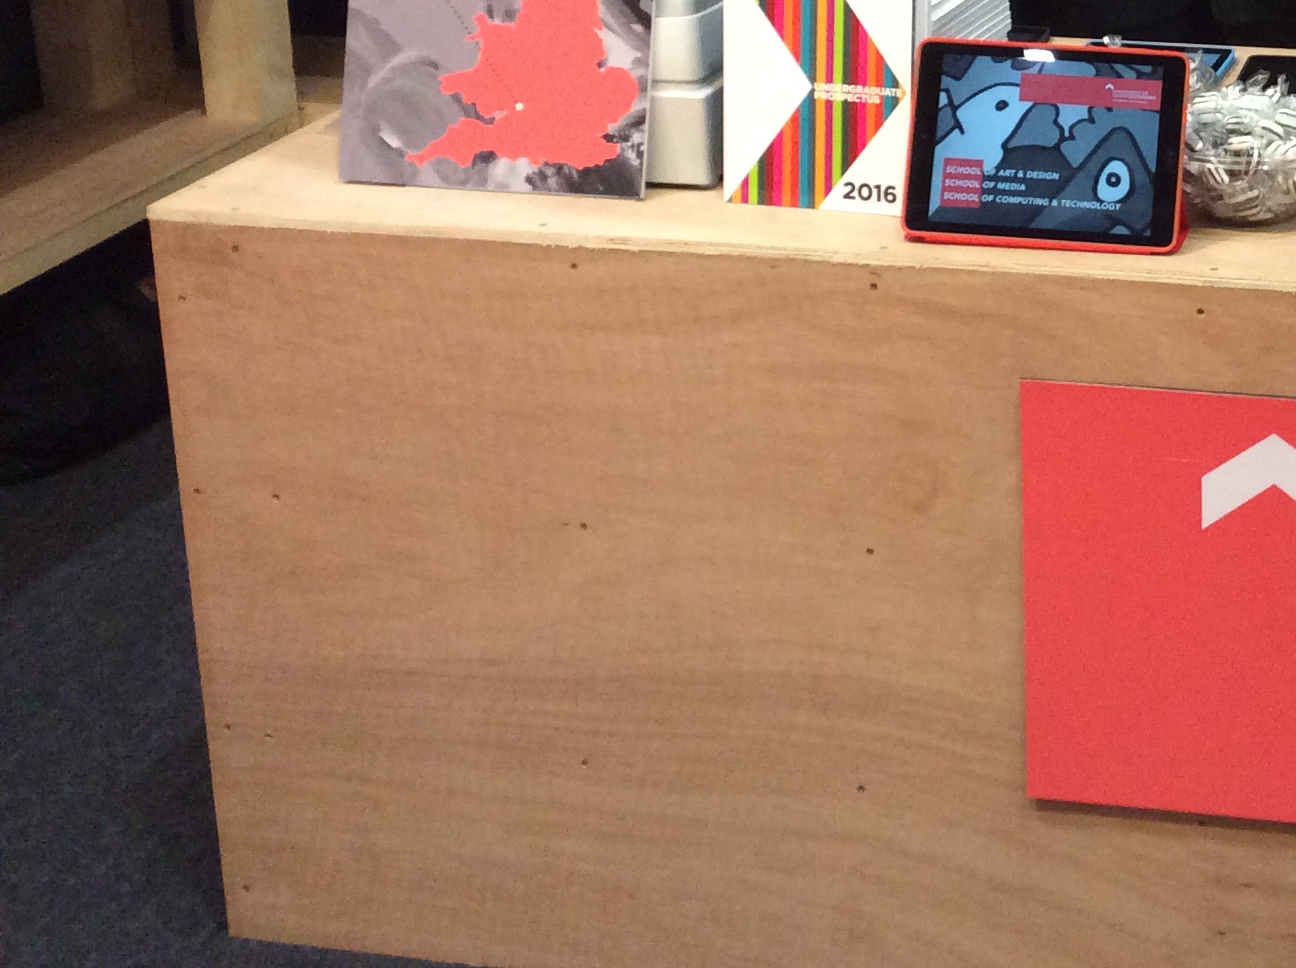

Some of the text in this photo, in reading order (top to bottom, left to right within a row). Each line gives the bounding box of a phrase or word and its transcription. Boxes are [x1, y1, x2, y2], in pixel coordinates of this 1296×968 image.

[814, 82, 903, 97] UNDERGRADUATE
[814, 90, 880, 104] PROSPECTUS
[945, 166, 1060, 180] SCHOOL OF ART & DESIGN
[944, 179, 1026, 191] SCHOOL OF MEDIA
[843, 182, 897, 204] 2016
[943, 192, 979, 202] SCHOOL
[981, 194, 994, 202] OF
[995, 195, 1049, 206] COMPUTING
[1061, 199, 1122, 210] TECHNOLOGY
